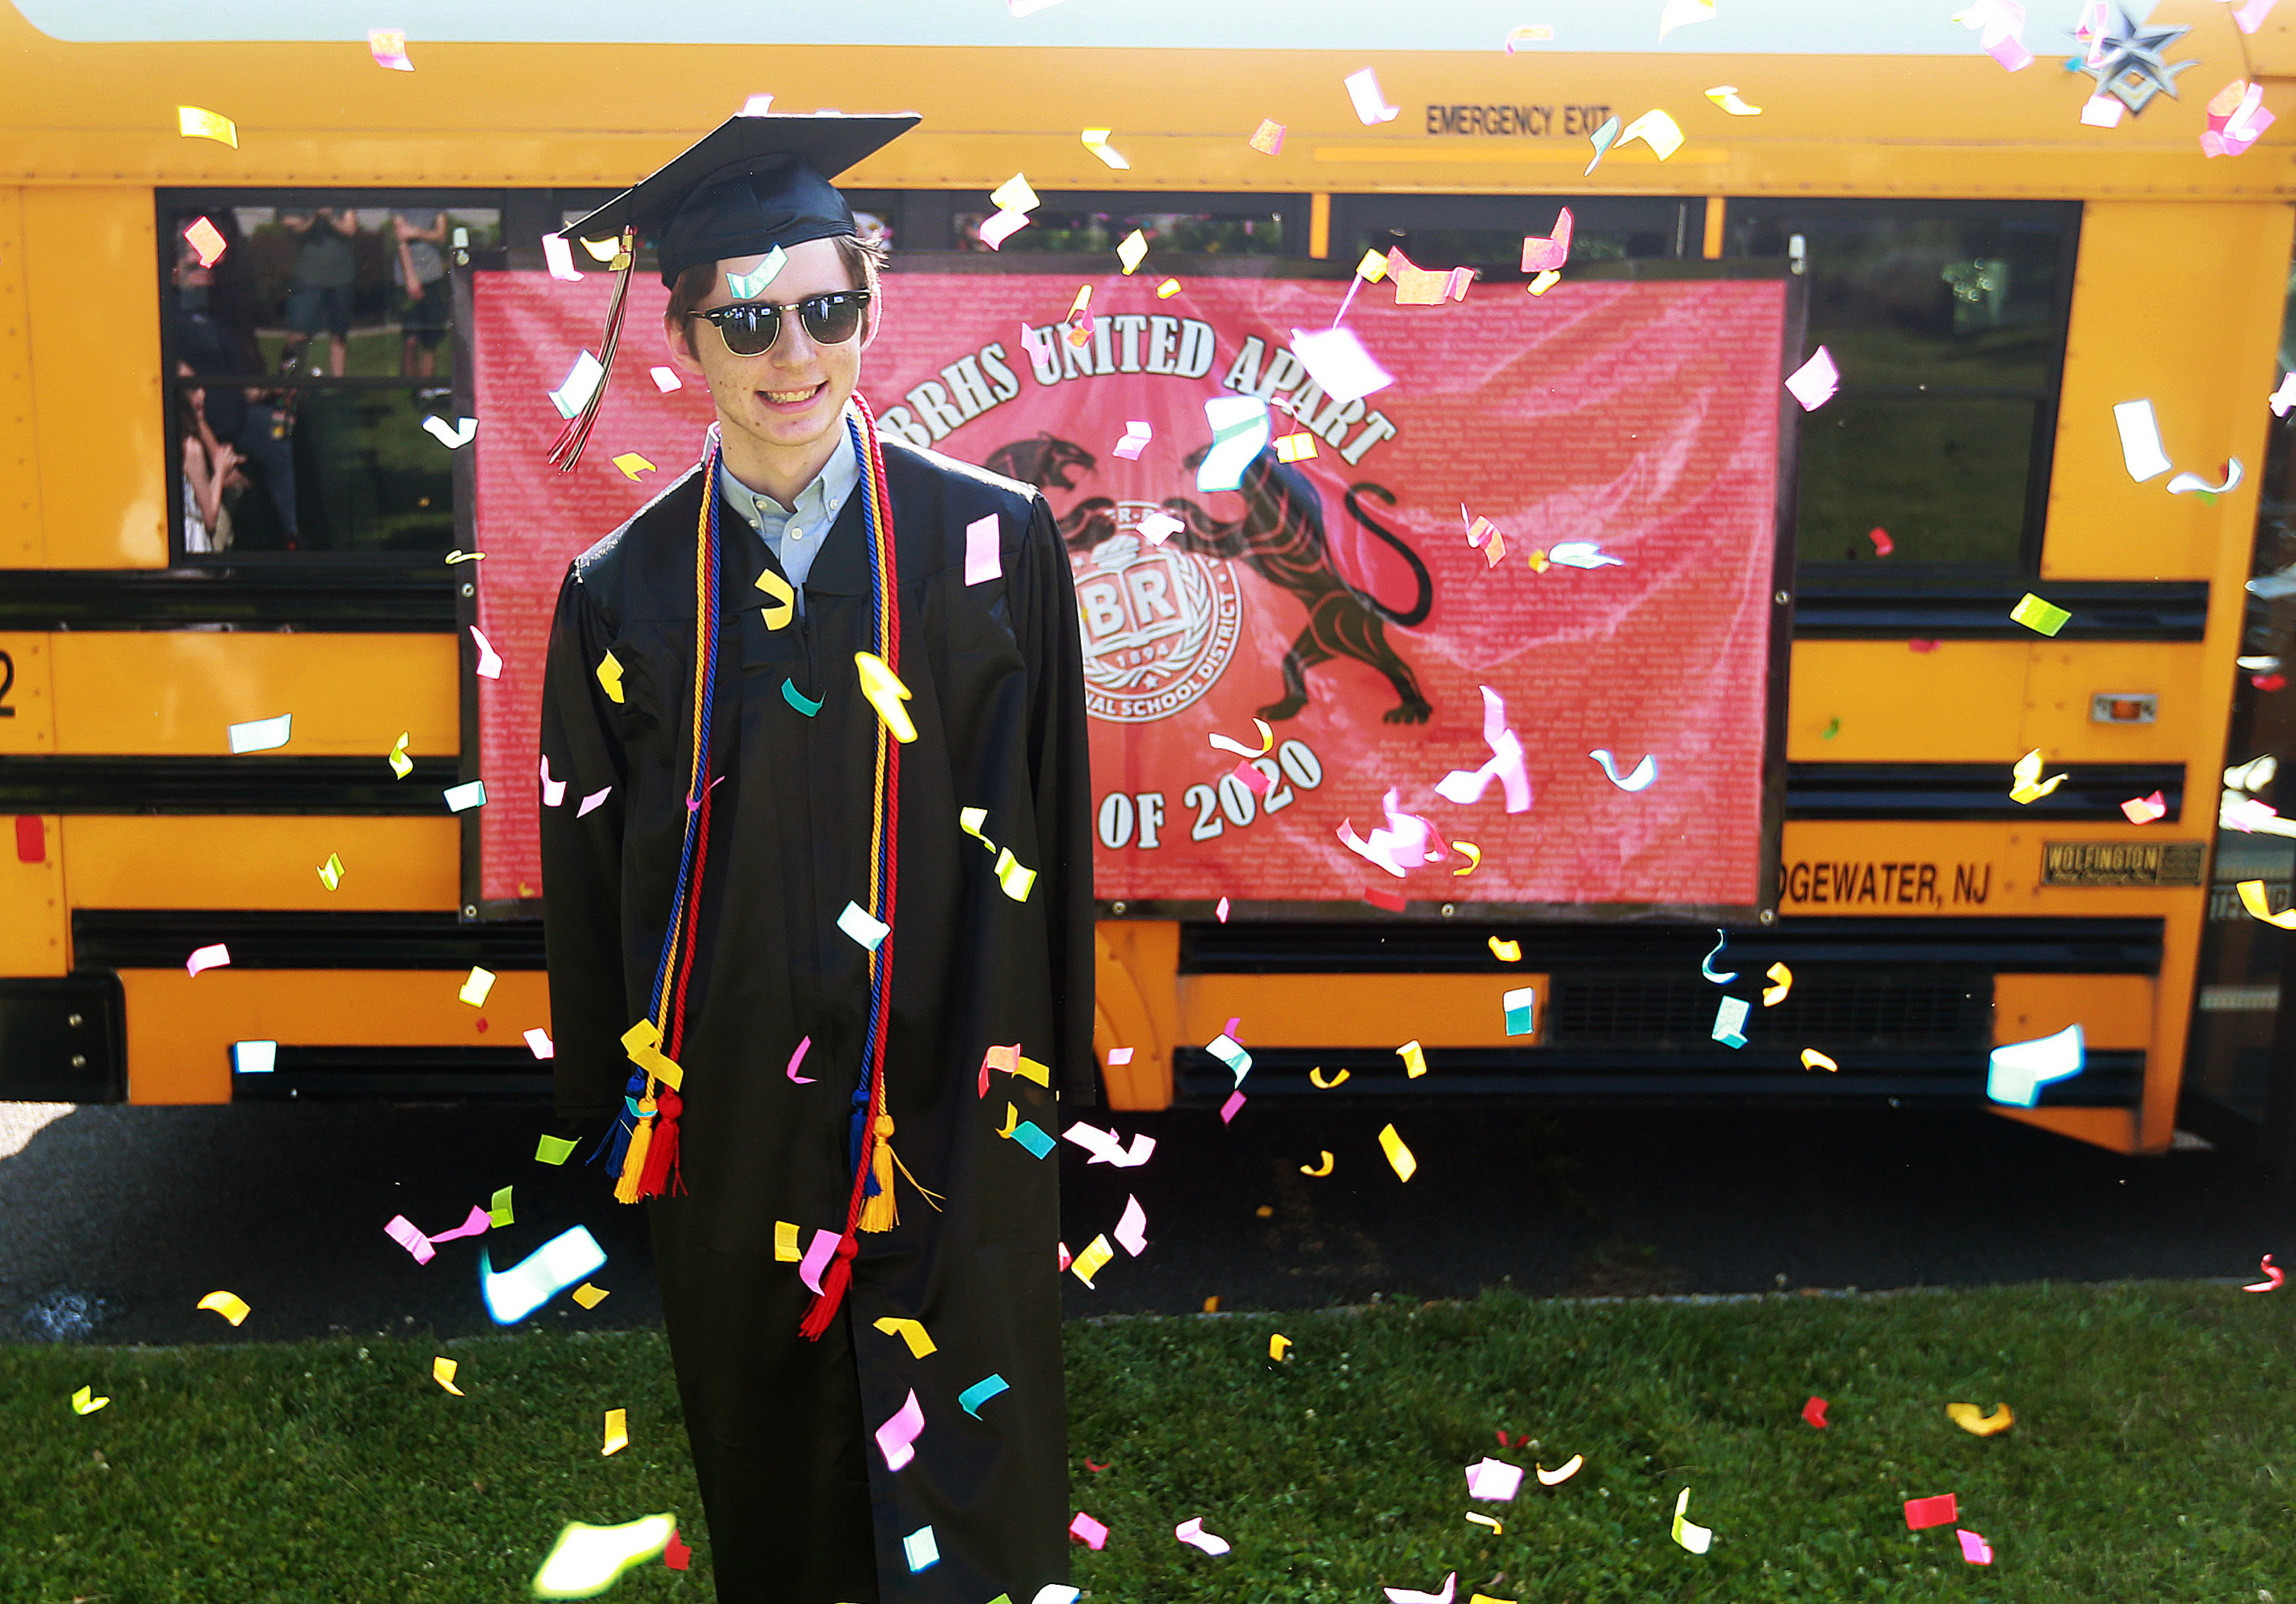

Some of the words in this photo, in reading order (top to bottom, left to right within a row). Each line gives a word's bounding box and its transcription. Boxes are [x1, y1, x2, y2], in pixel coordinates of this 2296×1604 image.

[1427, 105, 1554, 135] EMERGENCY
[1565, 105, 1612, 135] EXIT
[877, 342, 1020, 449] BRHS
[1030, 313, 1216, 386] UNITED
[1222, 333, 1399, 467] APART
[1121, 678, 1203, 716] SCHOOL
[1197, 591, 1236, 679] DISTRICT
[1097, 792, 1165, 850] OF
[1184, 739, 1324, 842] 2020
[1953, 862, 1990, 905] NJ
[2048, 846, 2159, 871] WOLFINGTON
